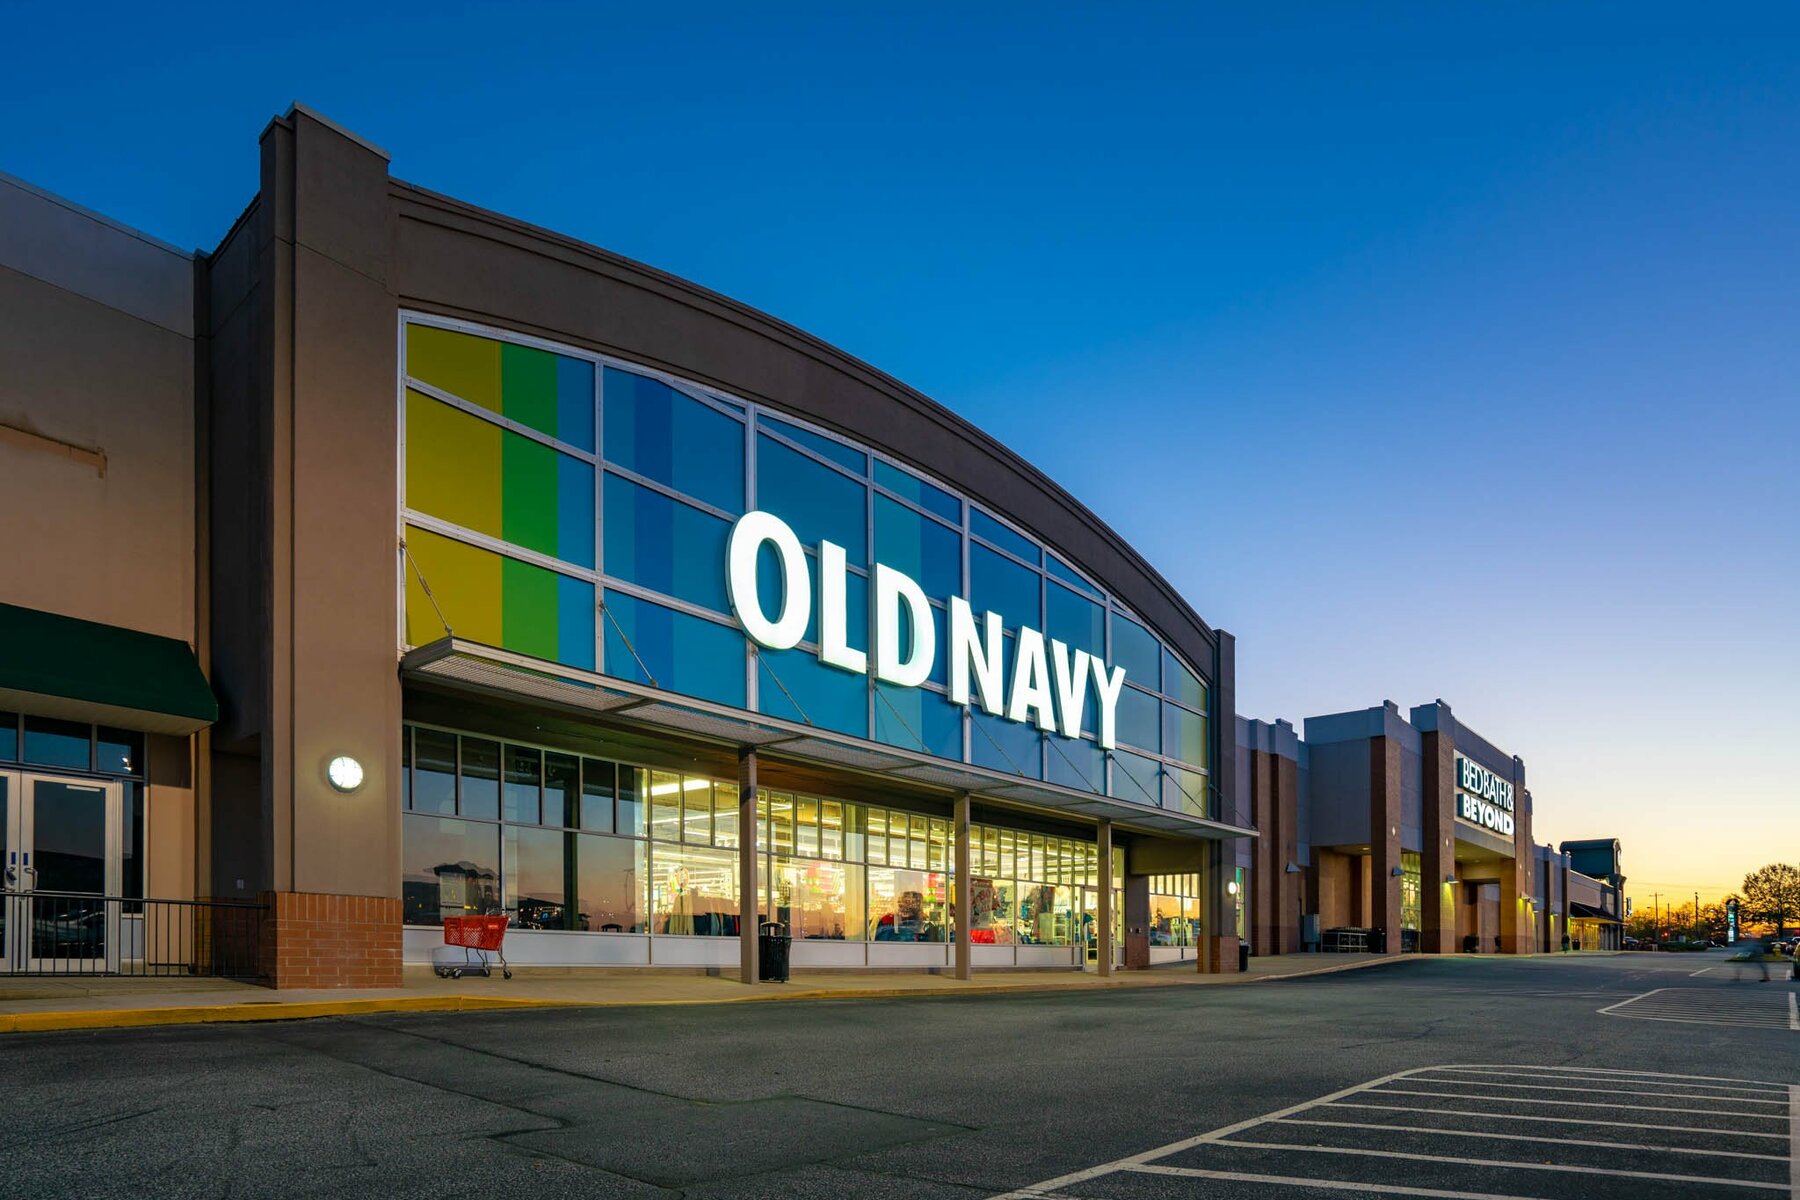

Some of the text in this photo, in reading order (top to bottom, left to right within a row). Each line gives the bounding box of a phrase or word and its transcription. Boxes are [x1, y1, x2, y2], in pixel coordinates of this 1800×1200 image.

[725, 510, 1127, 750] OLD NAVY
[1462, 757, 1514, 812] BED BATH &
[1462, 793, 1514, 836] BEYOND
